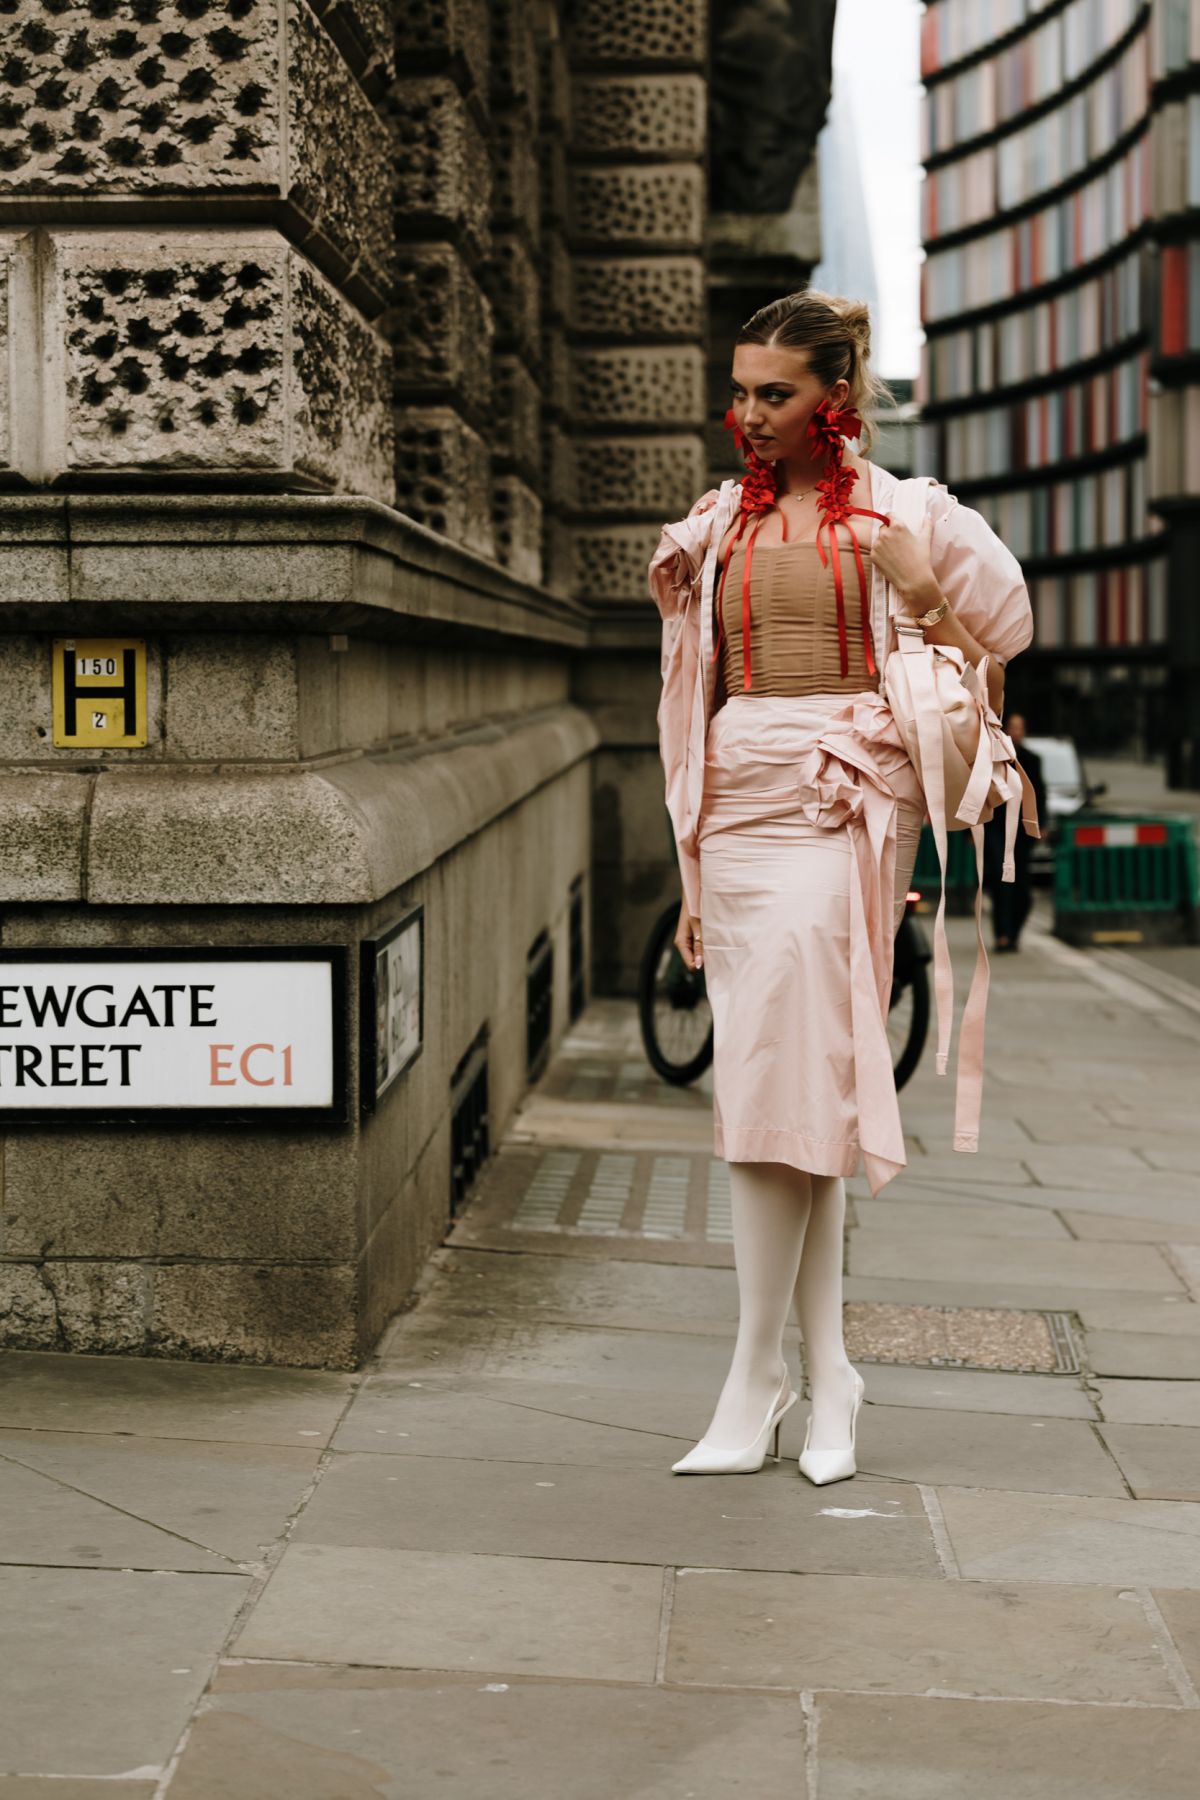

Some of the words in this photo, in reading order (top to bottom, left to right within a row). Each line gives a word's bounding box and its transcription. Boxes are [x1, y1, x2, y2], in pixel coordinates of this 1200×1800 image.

[81, 658, 115, 675] 150
[64, 649, 136, 736] H
[94, 712, 105, 728] 2
[0, 985, 218, 1028] EWGATE
[209, 1043, 293, 1086] EC1
